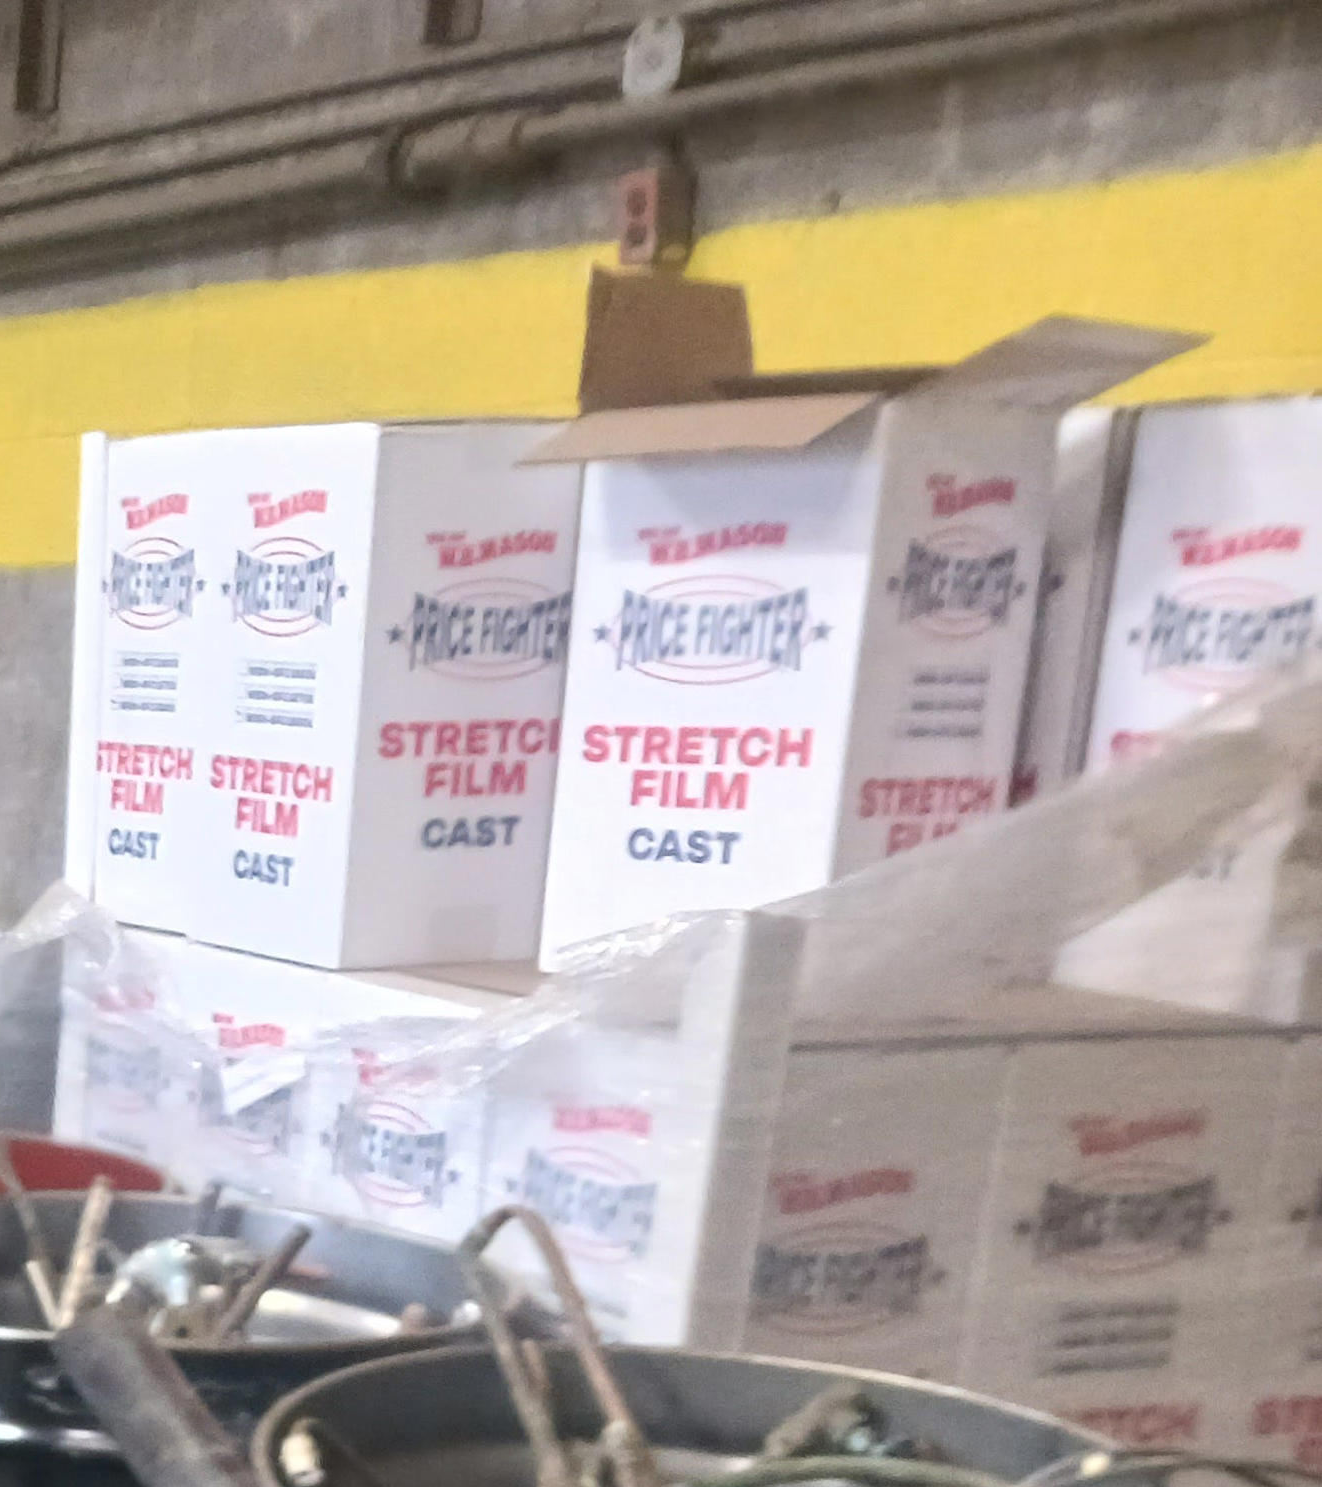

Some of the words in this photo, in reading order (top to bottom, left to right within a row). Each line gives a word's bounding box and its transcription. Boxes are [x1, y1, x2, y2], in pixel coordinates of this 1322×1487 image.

[409, 590, 475, 671] PRICE
[616, 588, 691, 671] PRICE
[694, 586, 809, 671] FIGHTER
[583, 725, 814, 768] STRETCH
[111, 778, 165, 815] FILM
[210, 754, 334, 802] STRETCH
[423, 761, 528, 798] FILM
[629, 769, 748, 811] FILM
[234, 797, 299, 838] FILM
[420, 816, 522, 849] CAST
[108, 828, 161, 860] CAST
[627, 828, 742, 865] CAST
[233, 849, 295, 887] CAST
